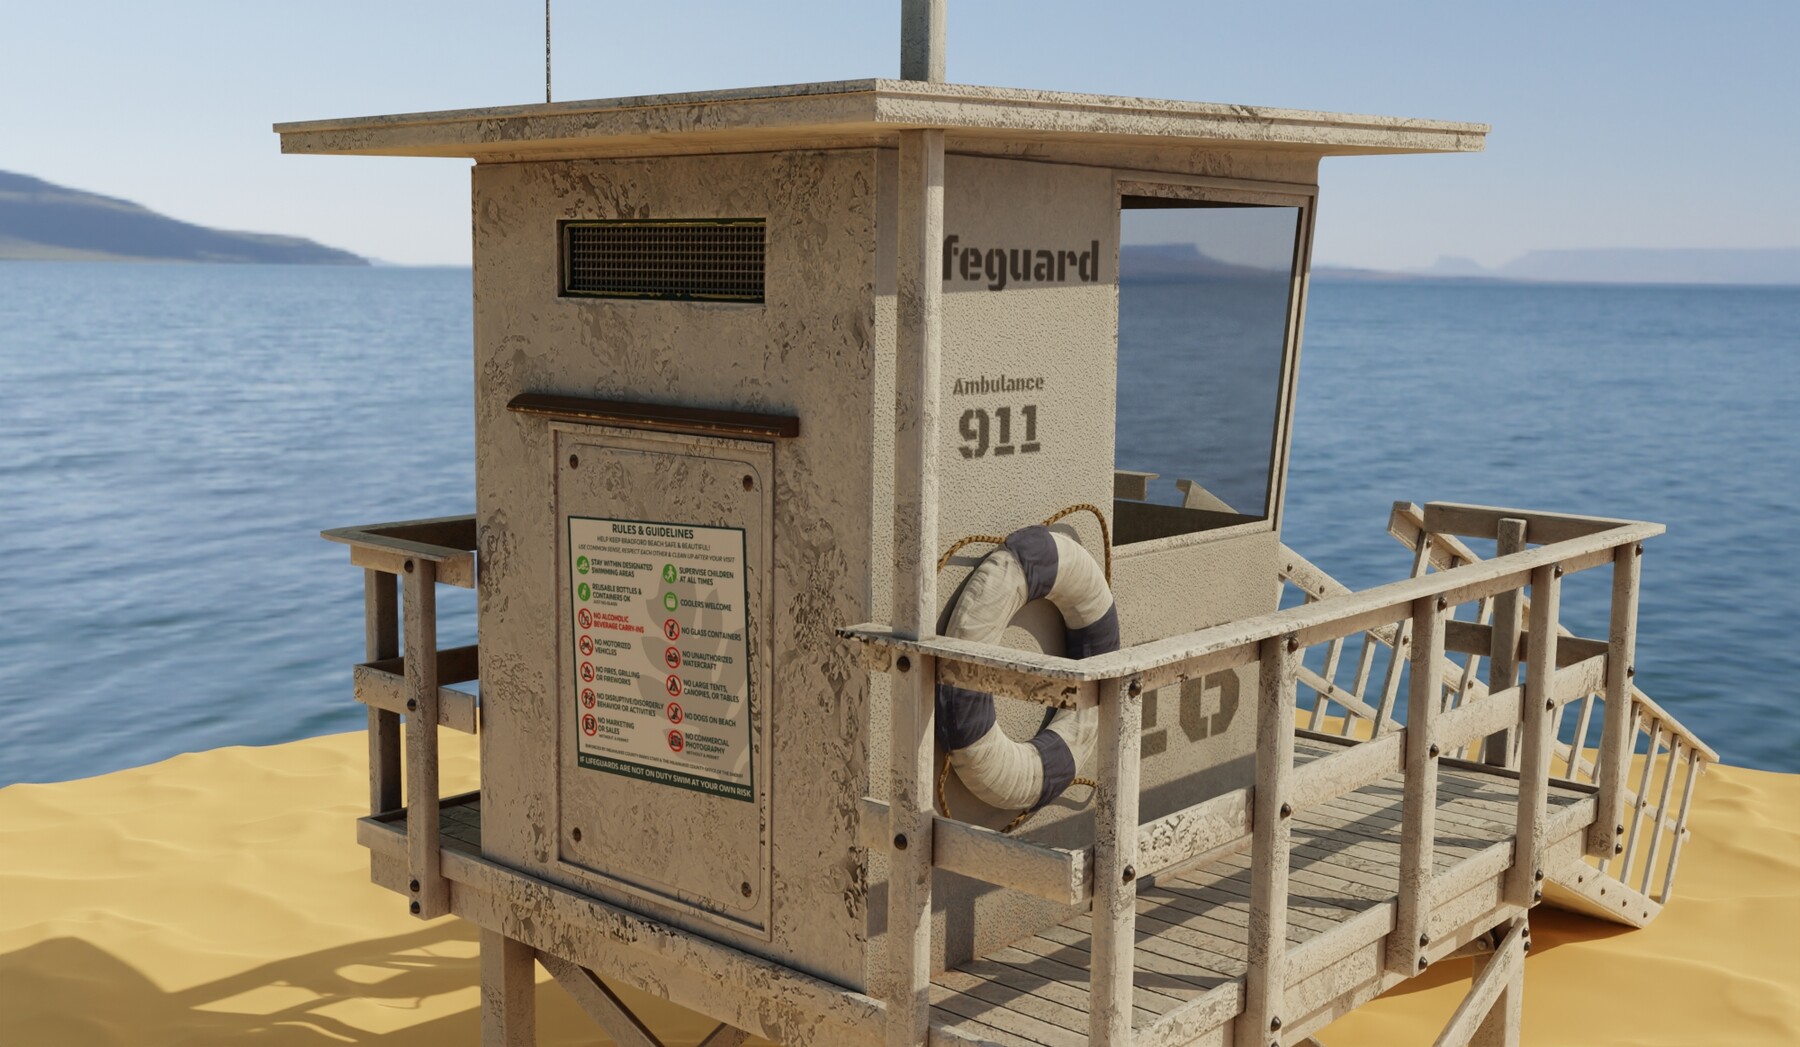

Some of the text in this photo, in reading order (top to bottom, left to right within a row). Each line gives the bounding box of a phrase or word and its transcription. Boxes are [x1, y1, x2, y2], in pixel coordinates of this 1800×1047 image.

[953, 374, 1045, 396] Ambulance
[958, 404, 1041, 459] 911
[612, 524, 694, 539] RULES & GUIDELINES
[621, 537, 647, 546] BRADFORD
[648, 539, 664, 547] BEACH
[681, 543, 711, 551] BEAUTIFUL!
[604, 560, 622, 568] WITHIN
[622, 561, 653, 571] DESIGNATED
[591, 567, 635, 578] SWIMMING AREAS
[679, 567, 734, 579] SUPERVISE CHILDREN
[697, 578, 713, 586] TIMES
[592, 583, 616, 592] REUSABLE
[616, 585, 638, 594] BOTTLES
[592, 591, 622, 601] CONTAINERS
[680, 599, 732, 611] COOLERS WELCOME
[602, 613, 629, 623] ALCOHOLIC
[593, 620, 644, 633] BEVERAGE CARRY-INS
[681, 627, 742, 641] NO GLASS CONTAINERS
[594, 638, 631, 650] NO MOTORIZED
[595, 647, 617, 656] VEHICLES
[682, 650, 733, 664] NO UNAUTHORIZED
[682, 659, 717, 670] WATERCRAFT
[603, 667, 618, 676] FIRES,
[618, 669, 640, 679] GRILLING
[603, 675, 631, 686] FIREWORKS
[692, 681, 709, 690] LARGE
[710, 683, 728, 693] TENTS,
[597, 692, 664, 710] NO DISRUPTIVE/DISORDERLY
[683, 688, 740, 703] CANOPIES, OR TABLES
[597, 701, 656, 717] BEHAVIOR OR ACTIVITIES
[606, 717, 635, 729] MARKETING
[684, 712, 736, 727] NO DOGS ON BEACH
[606, 726, 620, 735] SALES
[694, 734, 729, 747] COMMERCIAL
[685, 741, 725, 754] PHOTOGRAPHY
[585, 757, 619, 770] LIFEGUARDS
[620, 764, 631, 772] ARE
[632, 766, 645, 775] NOT
[645, 769, 655, 777] ON
[656, 771, 672, 781] DUTY
[673, 774, 691, 784] SWIM
[691, 778, 699, 786] AT
[700, 781, 718, 790] YOUR
[719, 784, 736, 794] OWN
[736, 787, 751, 797] RISK
